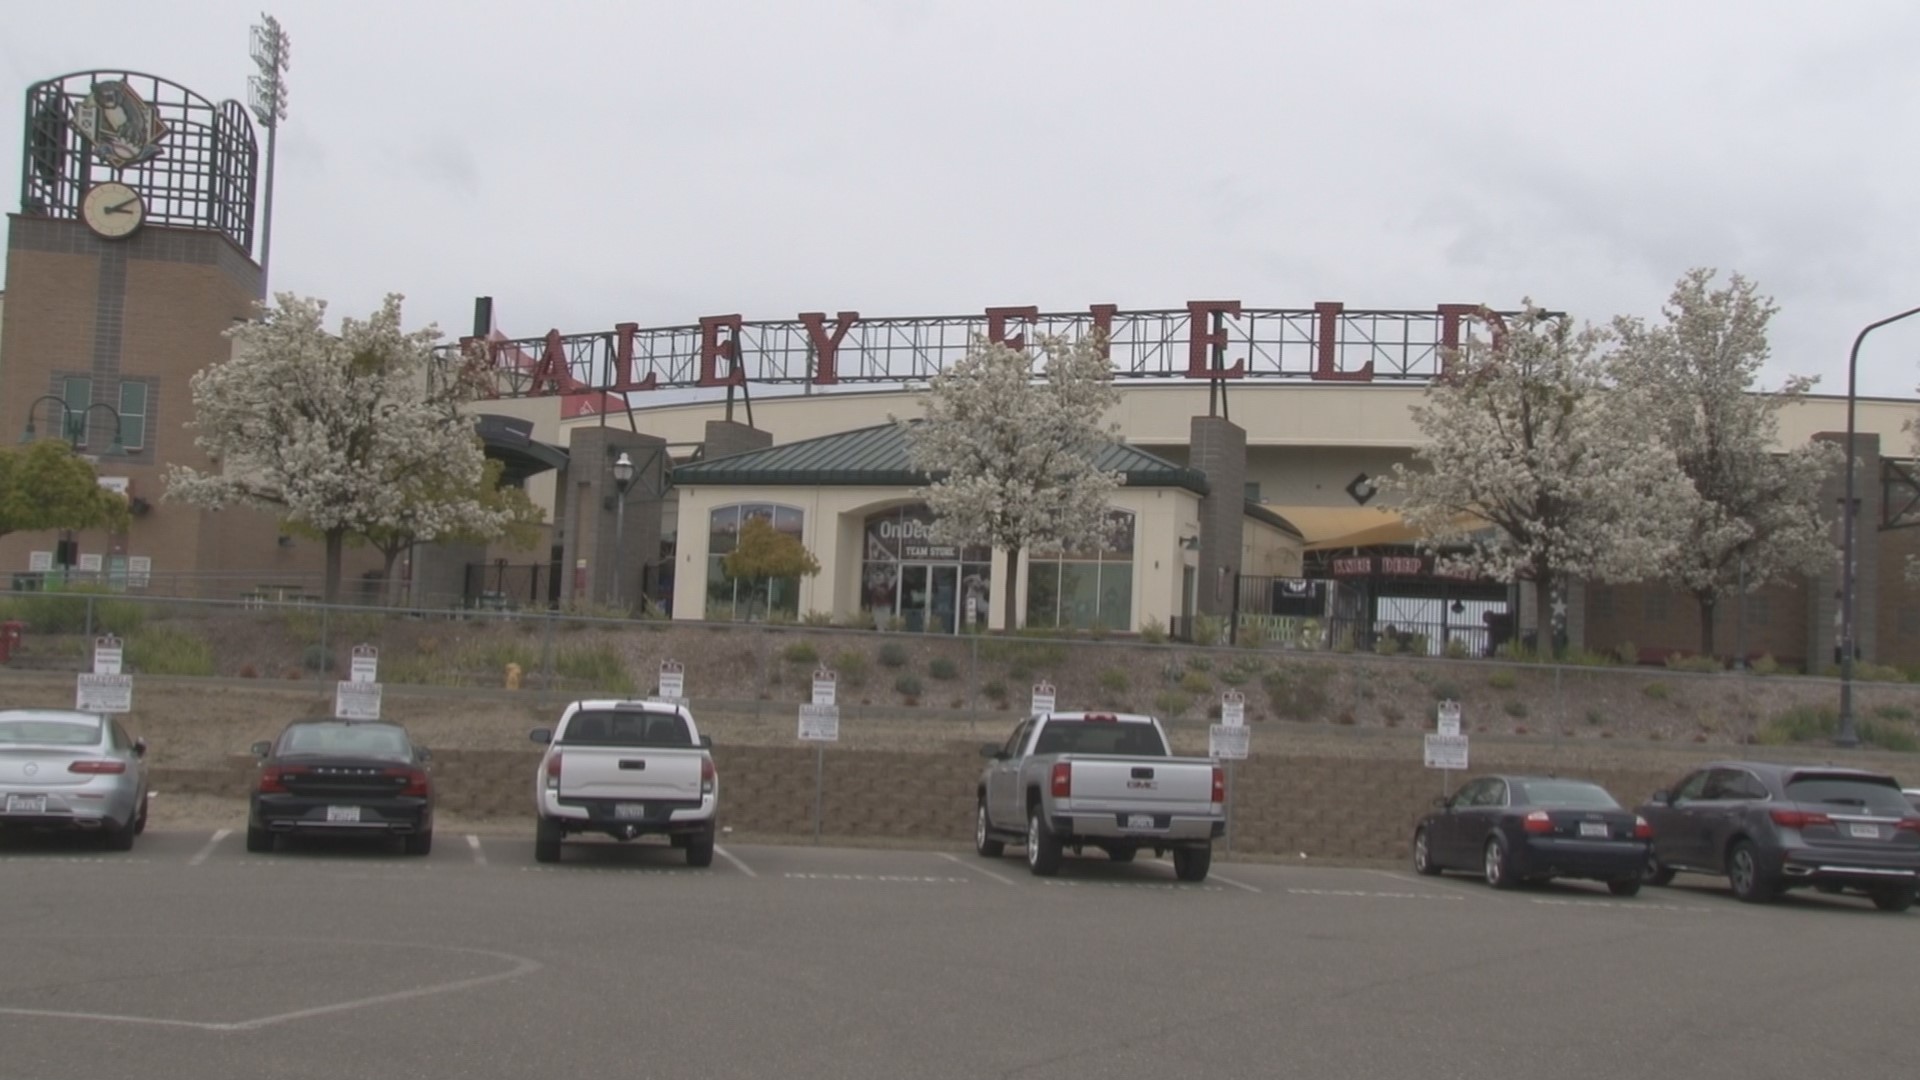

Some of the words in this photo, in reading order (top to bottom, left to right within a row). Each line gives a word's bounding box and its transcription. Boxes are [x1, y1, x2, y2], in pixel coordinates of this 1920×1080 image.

[985, 300, 1508, 383] FIELD
[880, 519, 934, 540] OnDec
[905, 546, 928, 556] TEAM
[930, 546, 955, 556] STORE
[1127, 781, 1158, 790] GMC
